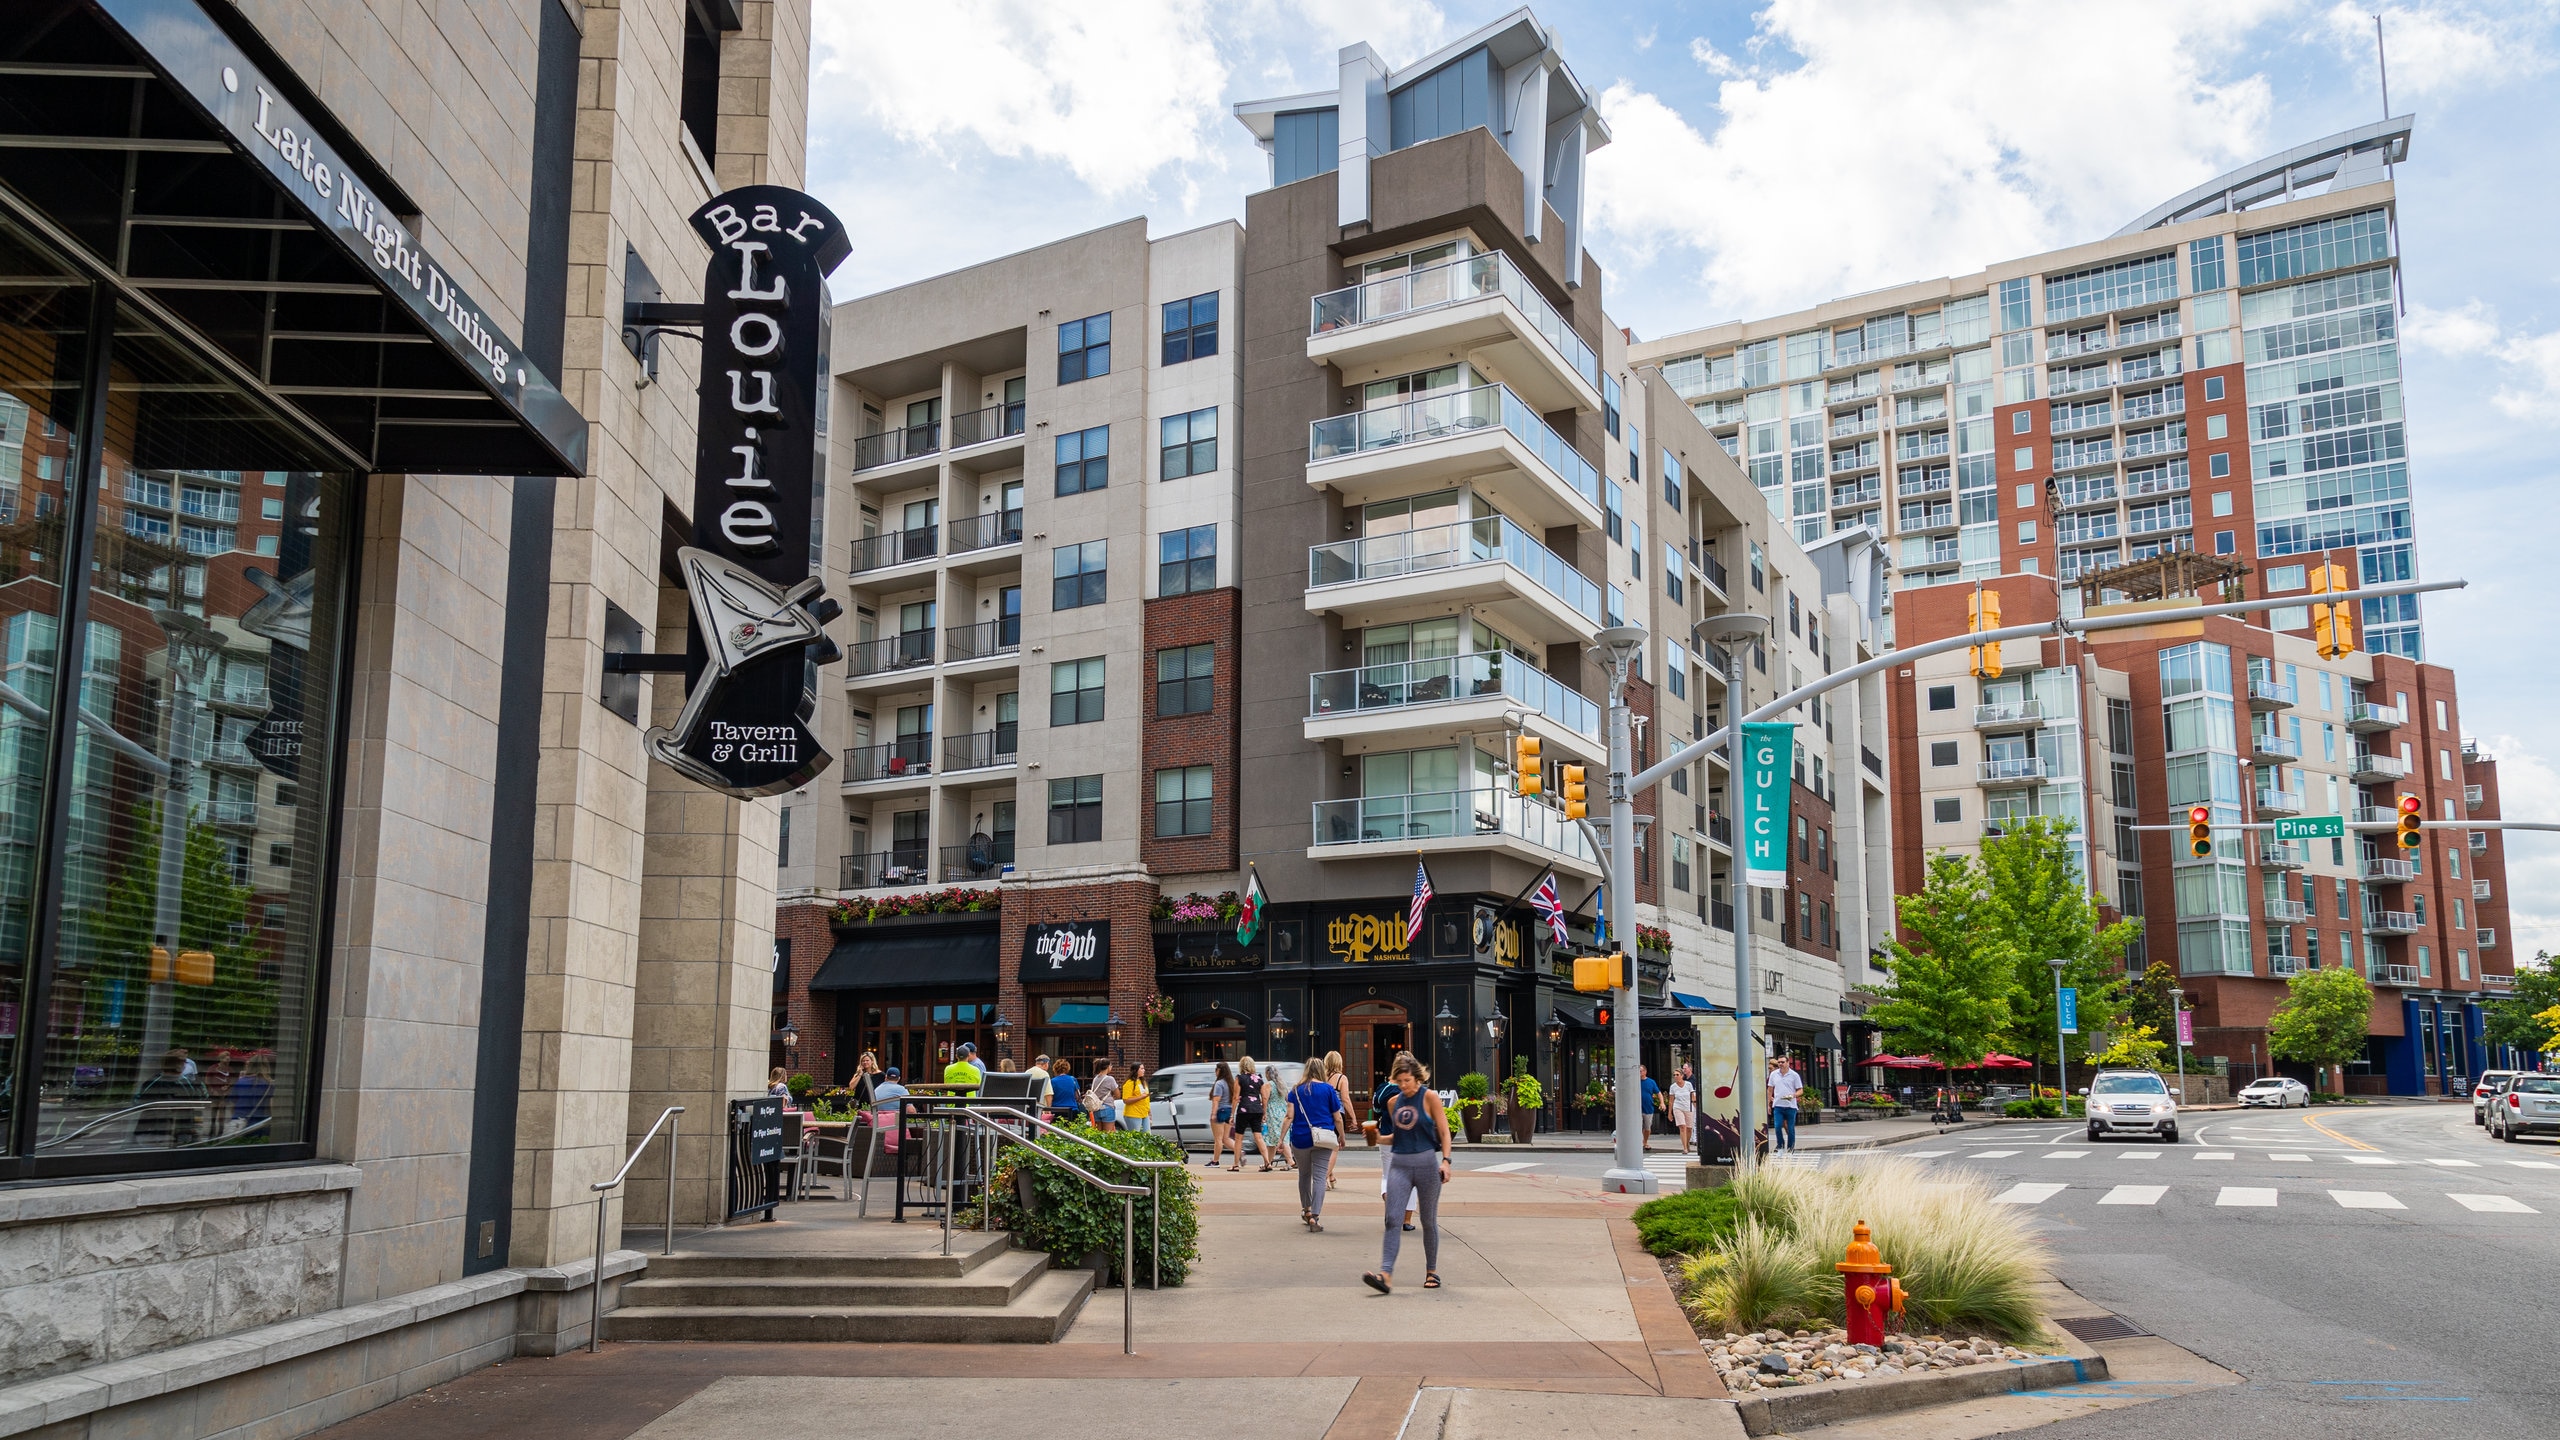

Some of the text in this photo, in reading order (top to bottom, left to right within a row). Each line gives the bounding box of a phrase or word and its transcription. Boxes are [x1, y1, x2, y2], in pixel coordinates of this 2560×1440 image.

[253, 86, 509, 384] Late Night Dining
[704, 204, 825, 246] Bar
[720, 241, 787, 546] Louie
[710, 721, 798, 741] Tavern
[1760, 734, 1773, 743] the
[711, 743, 798, 763] & Grill
[1754, 747, 1775, 858] GULCH
[2281, 822, 2318, 836] Pine
[1328, 910, 1408, 963] the Pub
[1036, 928, 1097, 969] the Pub
[1373, 953, 1411, 961] NASHVILLE
[1189, 956, 1236, 968] Pub Fayre
[1764, 969, 1784, 993] LOFT
[766, 1127, 781, 1136] Smoking
[759, 1147, 774, 1157] Allowed
